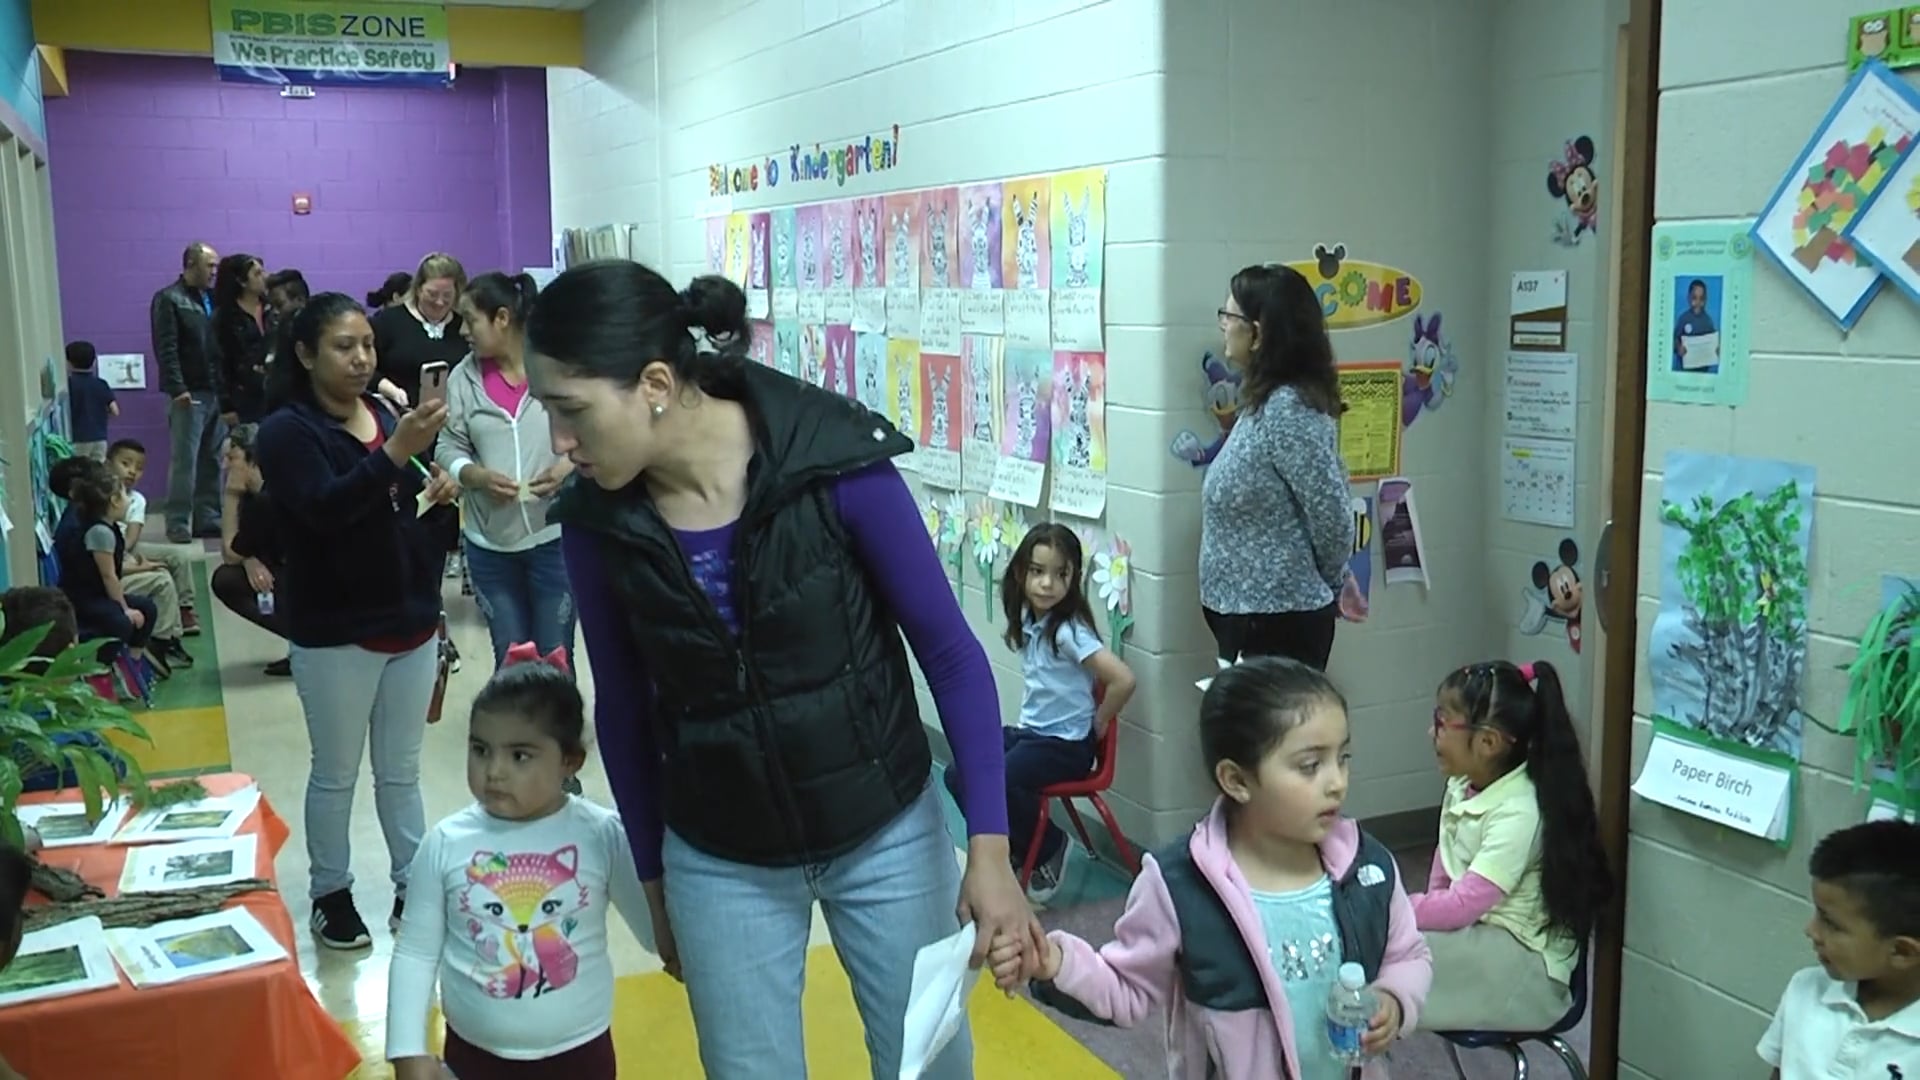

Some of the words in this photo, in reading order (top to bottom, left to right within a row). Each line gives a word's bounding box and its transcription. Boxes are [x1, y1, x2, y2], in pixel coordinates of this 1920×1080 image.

[231, 9, 337, 36] PBIS
[340, 14, 426, 38] ZONE
[230, 41, 267, 62] We
[269, 44, 359, 67] Practice
[363, 47, 436, 71] Safety
[764, 156, 779, 187] to
[790, 123, 900, 188] Kindergarten!
[1315, 270, 1412, 317] COME
[1516, 279, 1539, 292] A137
[1672, 758, 1714, 784] Paper
[1714, 771, 1753, 798] Birch
